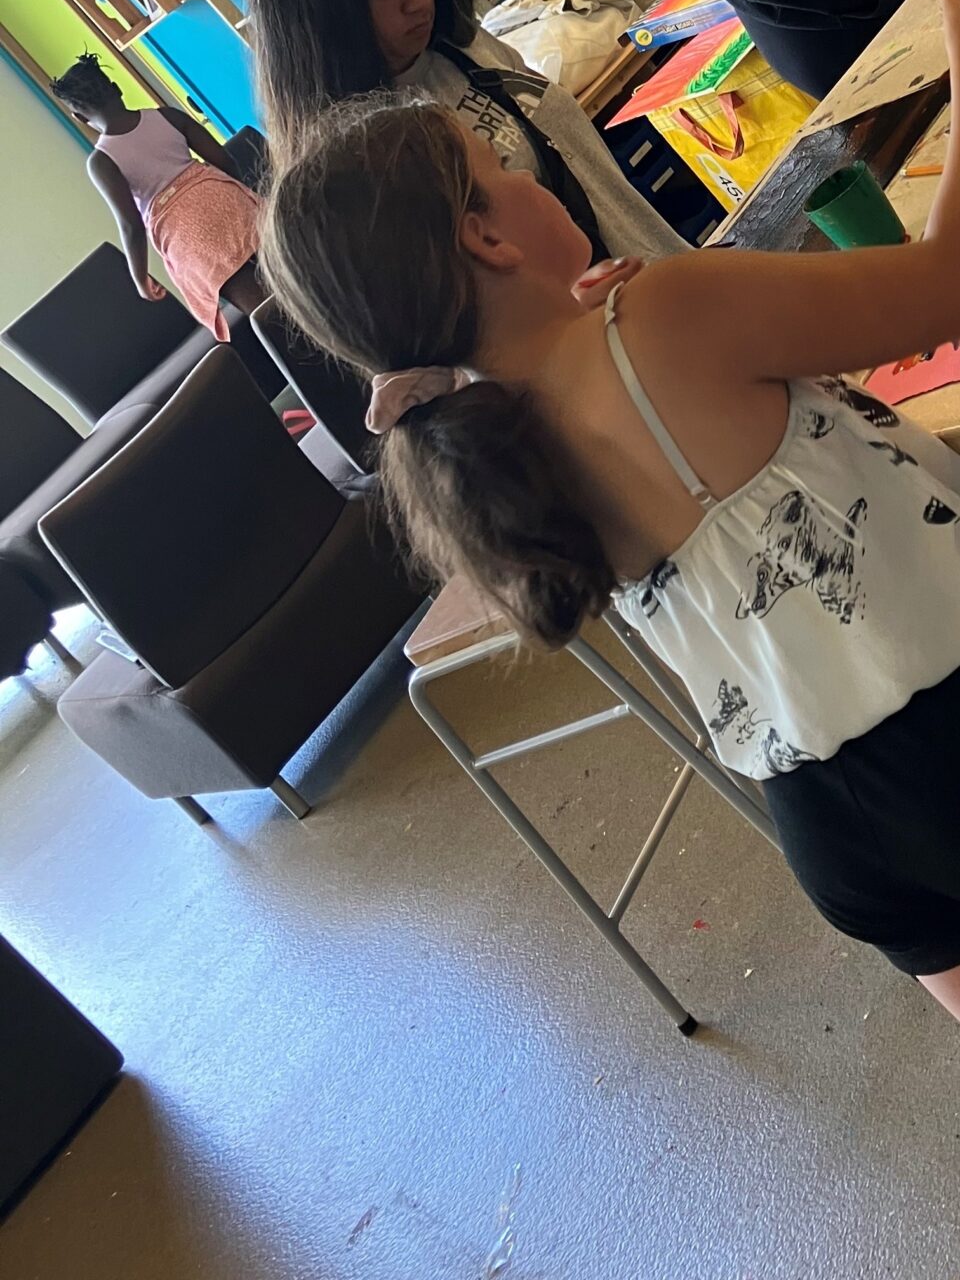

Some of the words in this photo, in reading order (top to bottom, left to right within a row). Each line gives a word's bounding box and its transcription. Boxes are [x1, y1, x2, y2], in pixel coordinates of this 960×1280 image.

[457, 86, 488, 114] TH
[472, 100, 506, 142] ORT
[719, 174, 743, 203] 45
